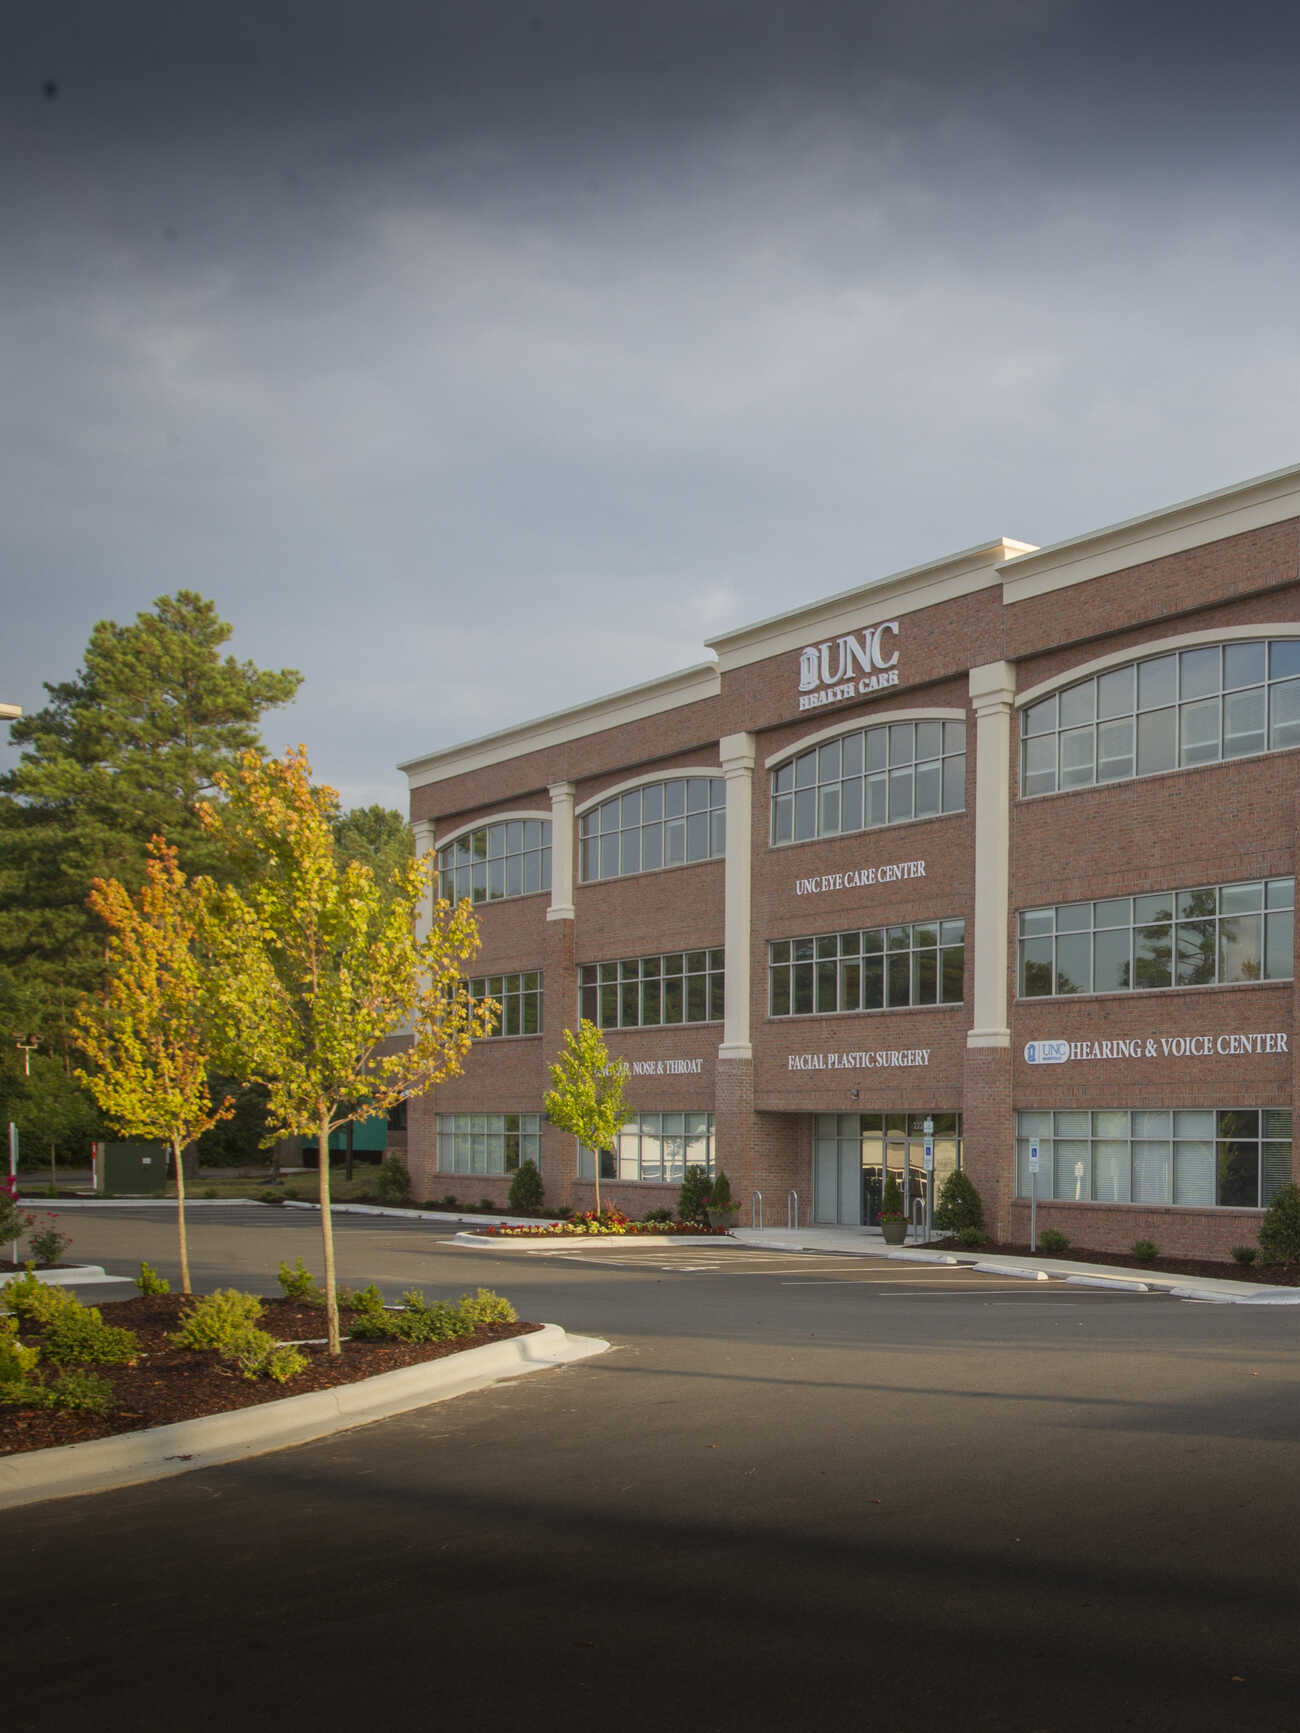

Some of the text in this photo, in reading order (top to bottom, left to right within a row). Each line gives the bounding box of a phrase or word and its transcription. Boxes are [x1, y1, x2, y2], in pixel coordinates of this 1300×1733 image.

[819, 621, 899, 685] UNC
[799, 669, 899, 711] HEALTH CARE
[795, 860, 926, 896] UNC EYE CARE CENTER
[788, 1049, 930, 1070] FACIAL PLASTIC SURGERY
[1070, 1032, 1288, 1060] HEARING & VOICE CENTER
[633, 1061, 655, 1075] NOSE
[657, 1060, 664, 1074] &
[664, 1058, 703, 1074] THROAT
